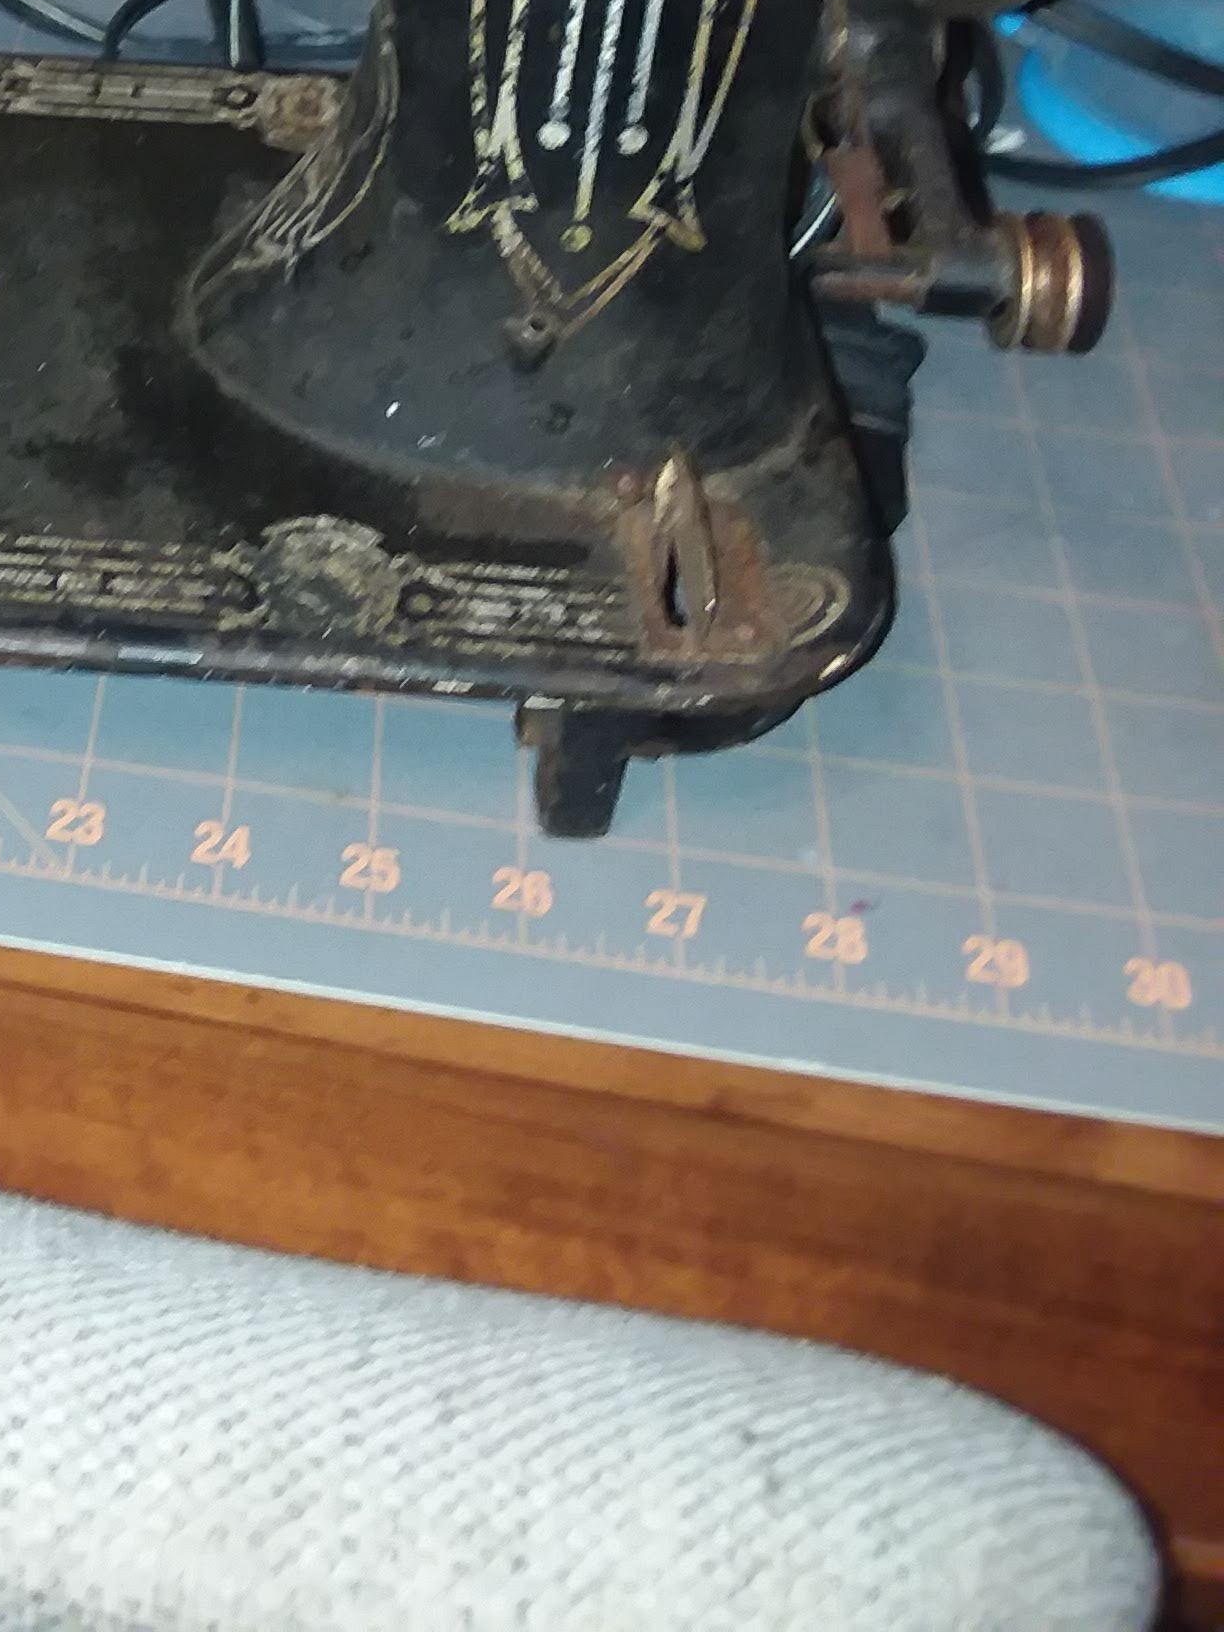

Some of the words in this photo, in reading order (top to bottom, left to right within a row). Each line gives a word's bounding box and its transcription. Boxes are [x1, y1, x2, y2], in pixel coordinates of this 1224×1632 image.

[47, 799, 106, 844] 23
[192, 821, 250, 869] 24
[341, 844, 399, 893] 25
[493, 867, 554, 915] 26
[645, 891, 707, 938] 27
[802, 913, 868, 963] 28
[963, 936, 1029, 988] 29
[1125, 958, 1190, 1009] 30
